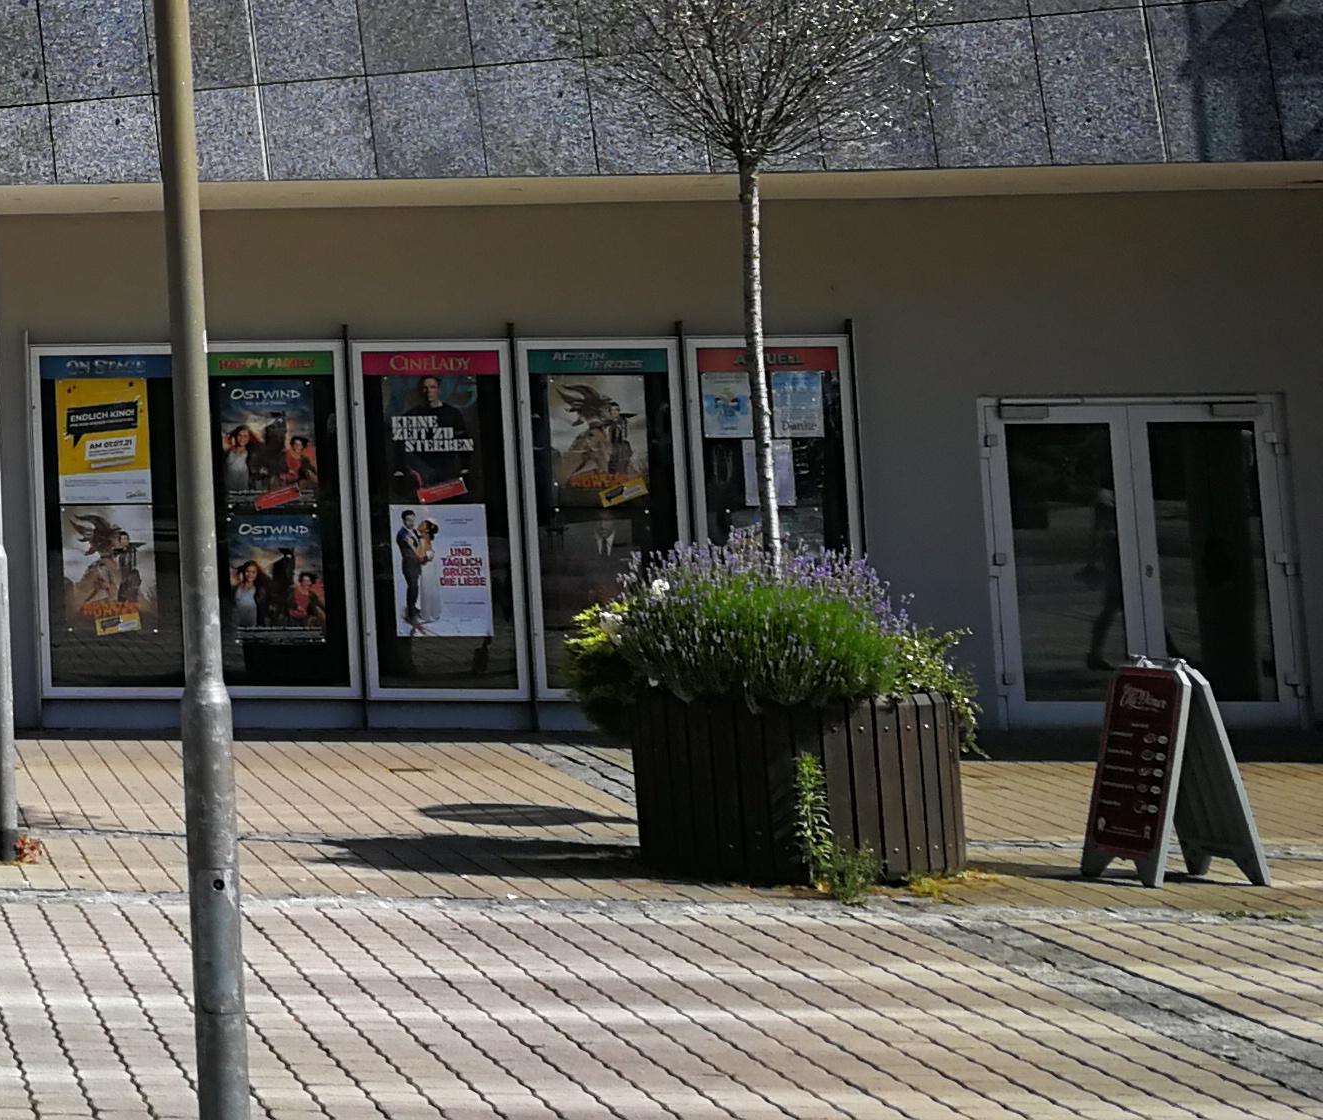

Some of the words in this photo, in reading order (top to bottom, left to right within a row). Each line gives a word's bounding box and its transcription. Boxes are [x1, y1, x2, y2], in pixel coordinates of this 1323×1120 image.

[230, 388, 301, 400] OSTWIND
[391, 415, 439, 428] KEINE
[392, 428, 430, 441] ZEIT
[405, 439, 475, 453] STERBEN
[238, 523, 309, 535] OSTWIND
[450, 547, 472, 556] UND
